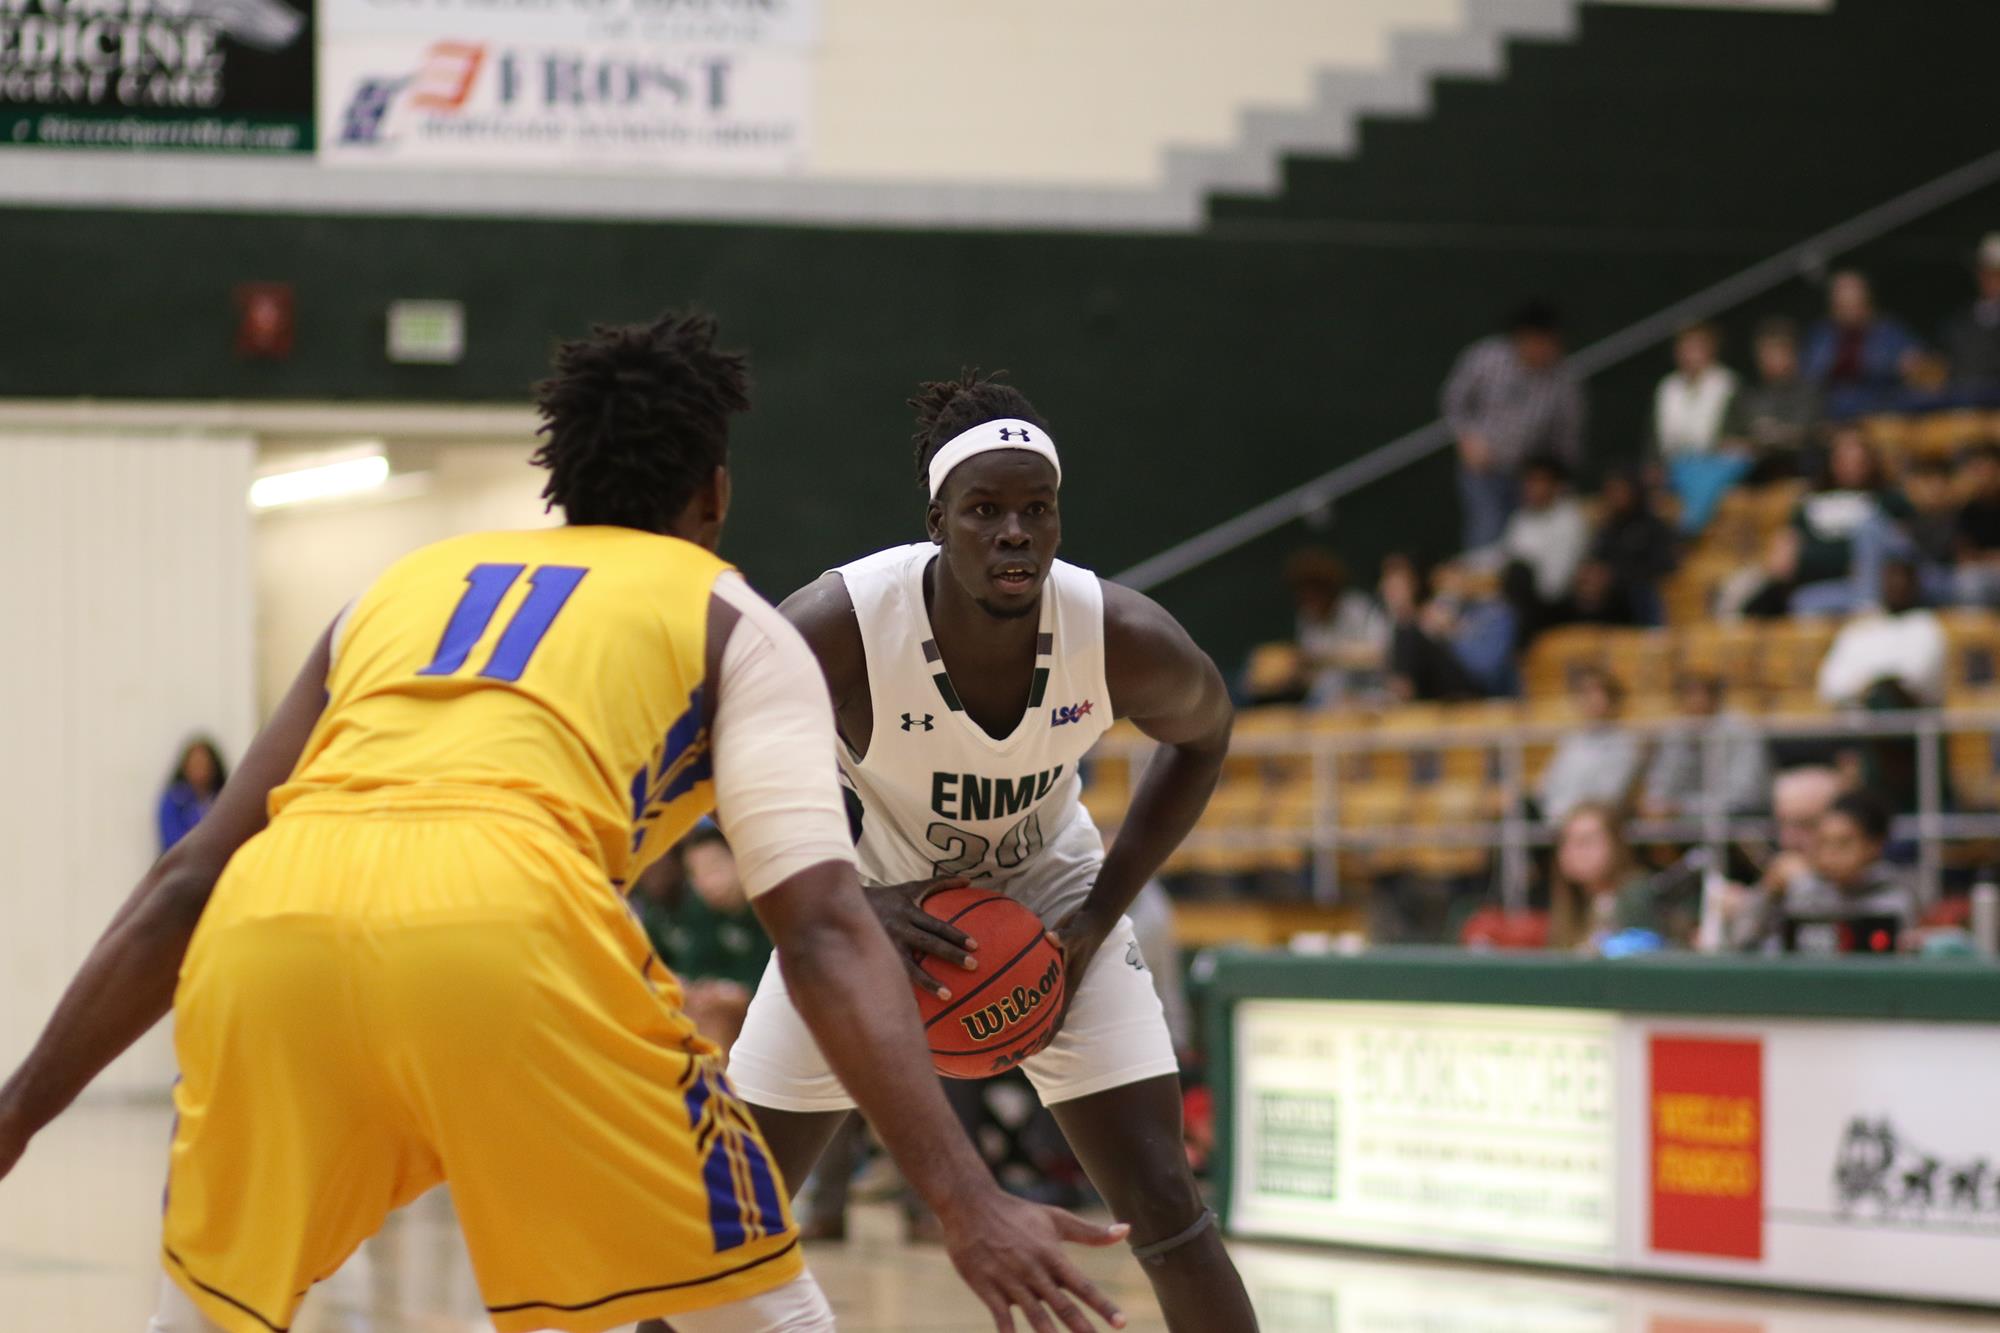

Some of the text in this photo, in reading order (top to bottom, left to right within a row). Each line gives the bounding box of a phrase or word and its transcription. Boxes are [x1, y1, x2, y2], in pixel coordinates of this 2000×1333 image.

[499, 48, 737, 111] FROST
[415, 563, 590, 682] 11
[926, 811, 1043, 878] 20
[961, 959, 1060, 1041] Wilson
[1658, 1093, 1754, 1144] WELLS
